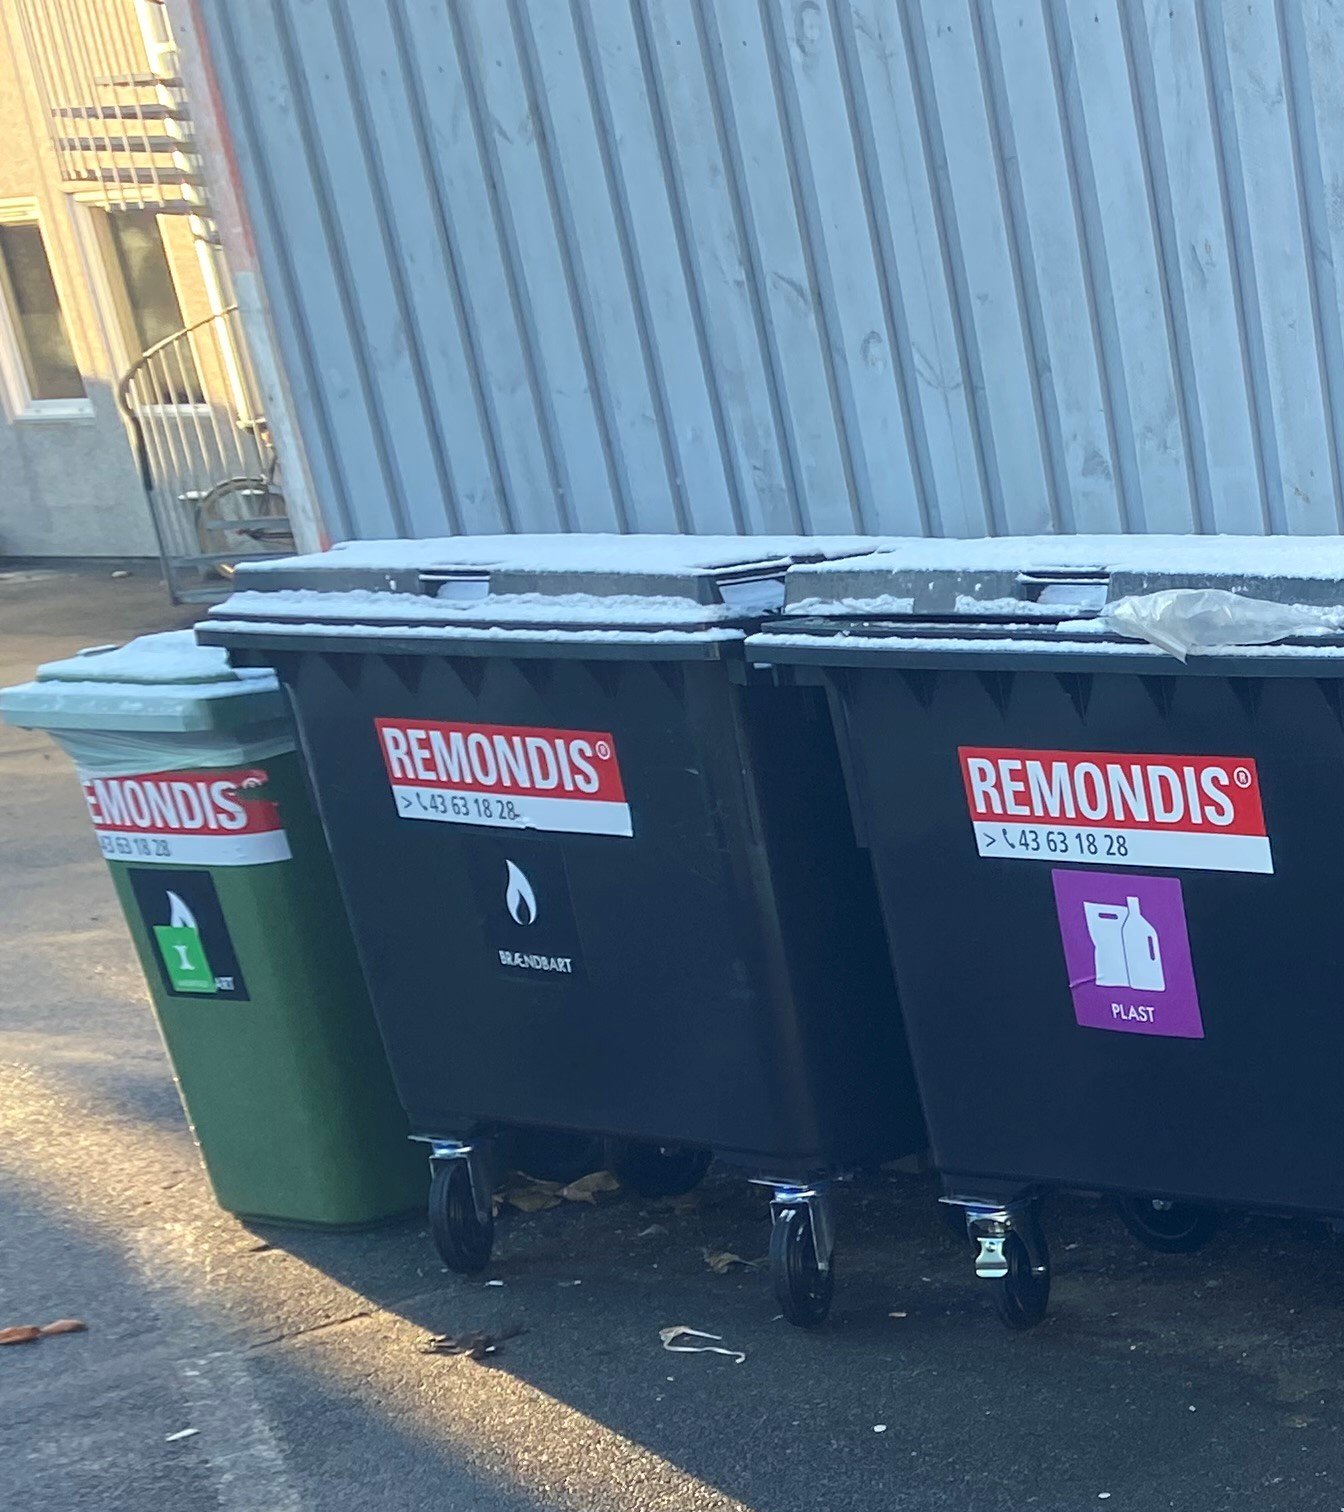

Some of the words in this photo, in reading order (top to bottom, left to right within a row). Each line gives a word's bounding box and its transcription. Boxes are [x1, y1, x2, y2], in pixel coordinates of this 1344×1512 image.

[83, 778, 248, 831] EMONDIS
[429, 793, 448, 815] 43
[451, 795, 470, 817] 63
[474, 797, 493, 819] 18
[496, 799, 517, 821] 28
[1018, 830, 1041, 852] 43
[1046, 831, 1069, 854] 63
[1075, 832, 1098, 856] 18
[1104, 834, 1129, 857] 28
[1111, 1003, 1155, 1023] PLAST
